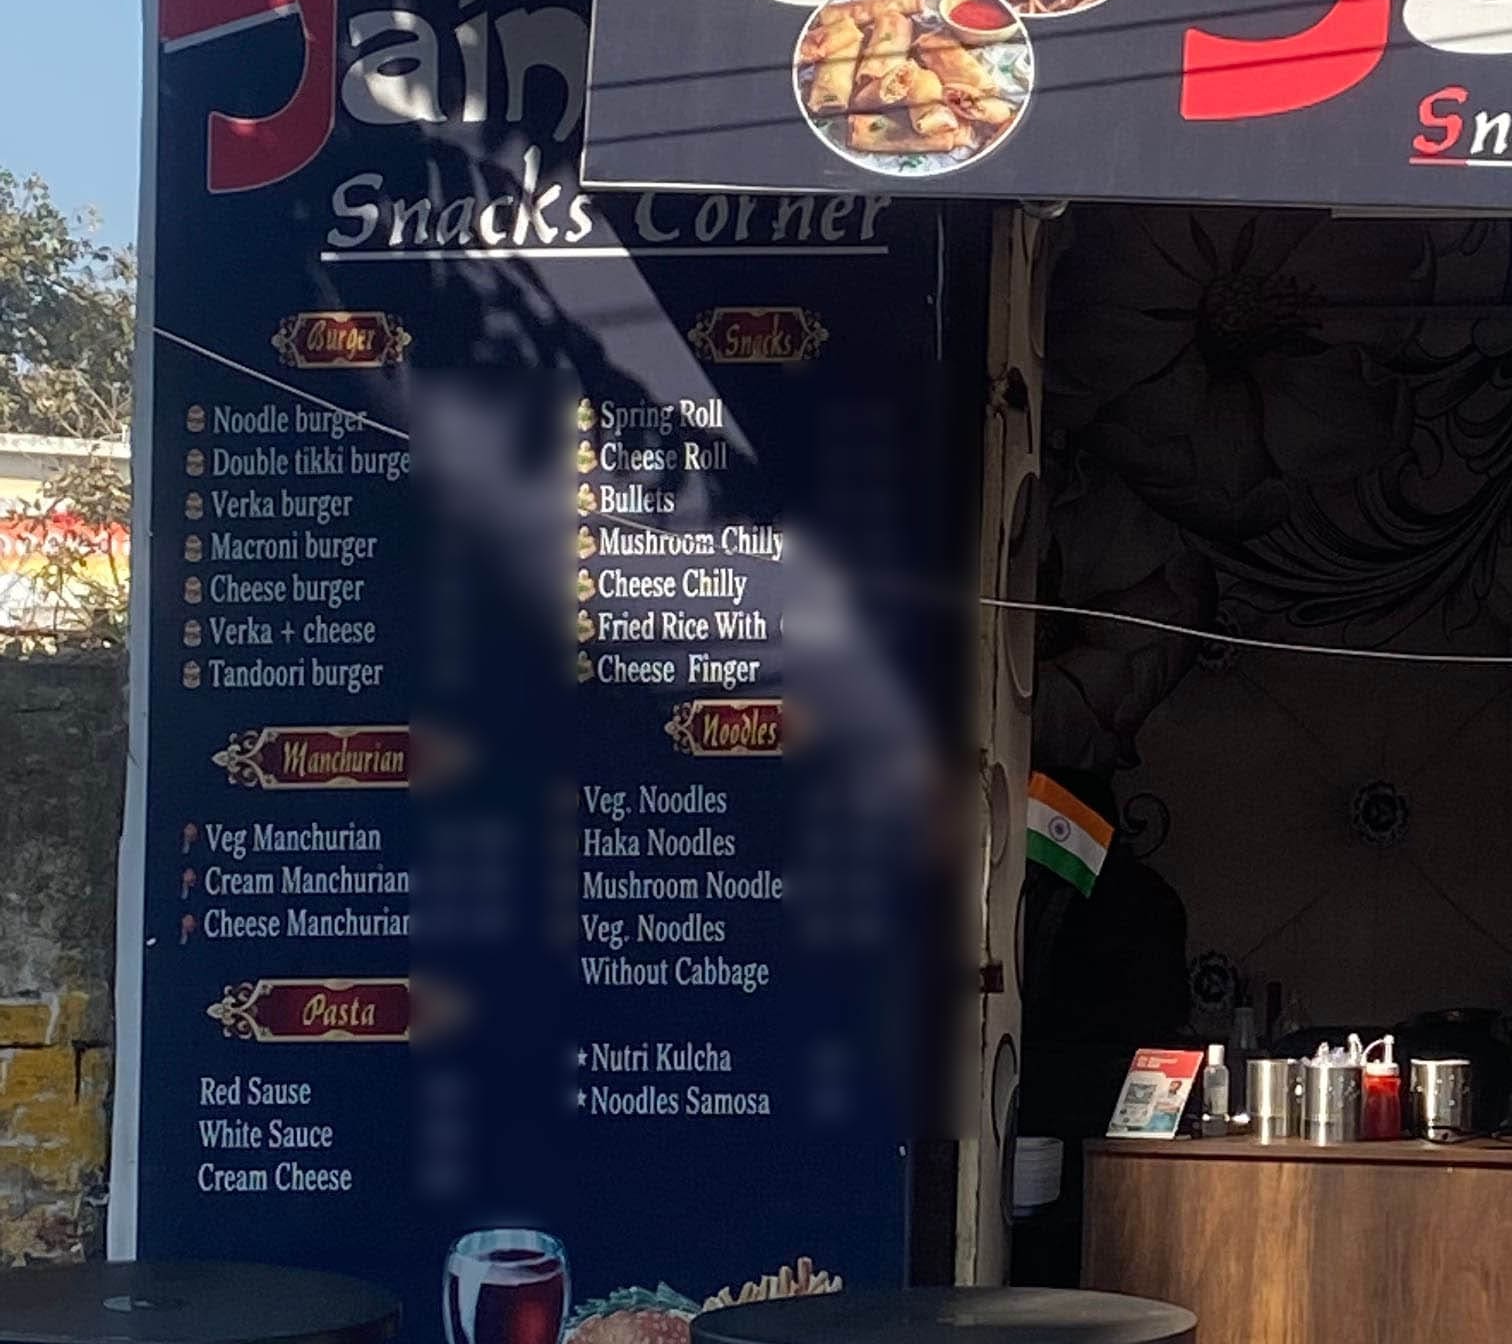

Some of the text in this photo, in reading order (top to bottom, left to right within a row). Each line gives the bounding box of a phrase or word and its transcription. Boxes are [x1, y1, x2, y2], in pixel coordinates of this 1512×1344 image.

[327, 144, 892, 247] Snacks Corner
[307, 321, 377, 360] Burger
[726, 314, 793, 355] Snacks
[212, 404, 367, 440] Noodle burger
[600, 398, 723, 434] Spring Roll
[212, 446, 410, 481] Double tikki burge
[600, 442, 727, 471] Cheese Roll
[211, 488, 353, 525] Verka burger
[599, 484, 675, 514] Bullets
[211, 531, 378, 566] Macroni burger
[599, 525, 784, 561] Mushroom Chilly
[210, 573, 365, 608] Cheese burger
[598, 568, 747, 605] Cheese Chilly
[209, 617, 273, 647] Verka
[303, 615, 376, 644] cheese
[598, 611, 655, 641] Fried
[661, 611, 709, 642] Rice
[713, 611, 767, 641] With
[209, 657, 384, 693] Tandoori burger
[597, 653, 761, 690] Cheese Finger
[703, 713, 777, 749] Noodles
[283, 738, 405, 779] Manchurian
[583, 784, 728, 821] Veg. Noodles
[205, 822, 382, 860] Veg Manchurian
[583, 827, 736, 857] Haka Noodles
[205, 864, 409, 896] Cream Manchurian
[582, 871, 699, 899] Mushroom
[204, 909, 280, 938] Cheese
[581, 913, 726, 950] Veg. Noodles
[581, 956, 769, 993] Without Cabbage
[303, 992, 376, 1026] Pasta
[591, 1042, 732, 1072] Nutri Kulcha
[199, 1077, 312, 1106] Red Sause
[590, 1085, 770, 1115] Noodles Samosa
[198, 1119, 333, 1149] White Sauce
[198, 1161, 353, 1192] Cream Cheese
